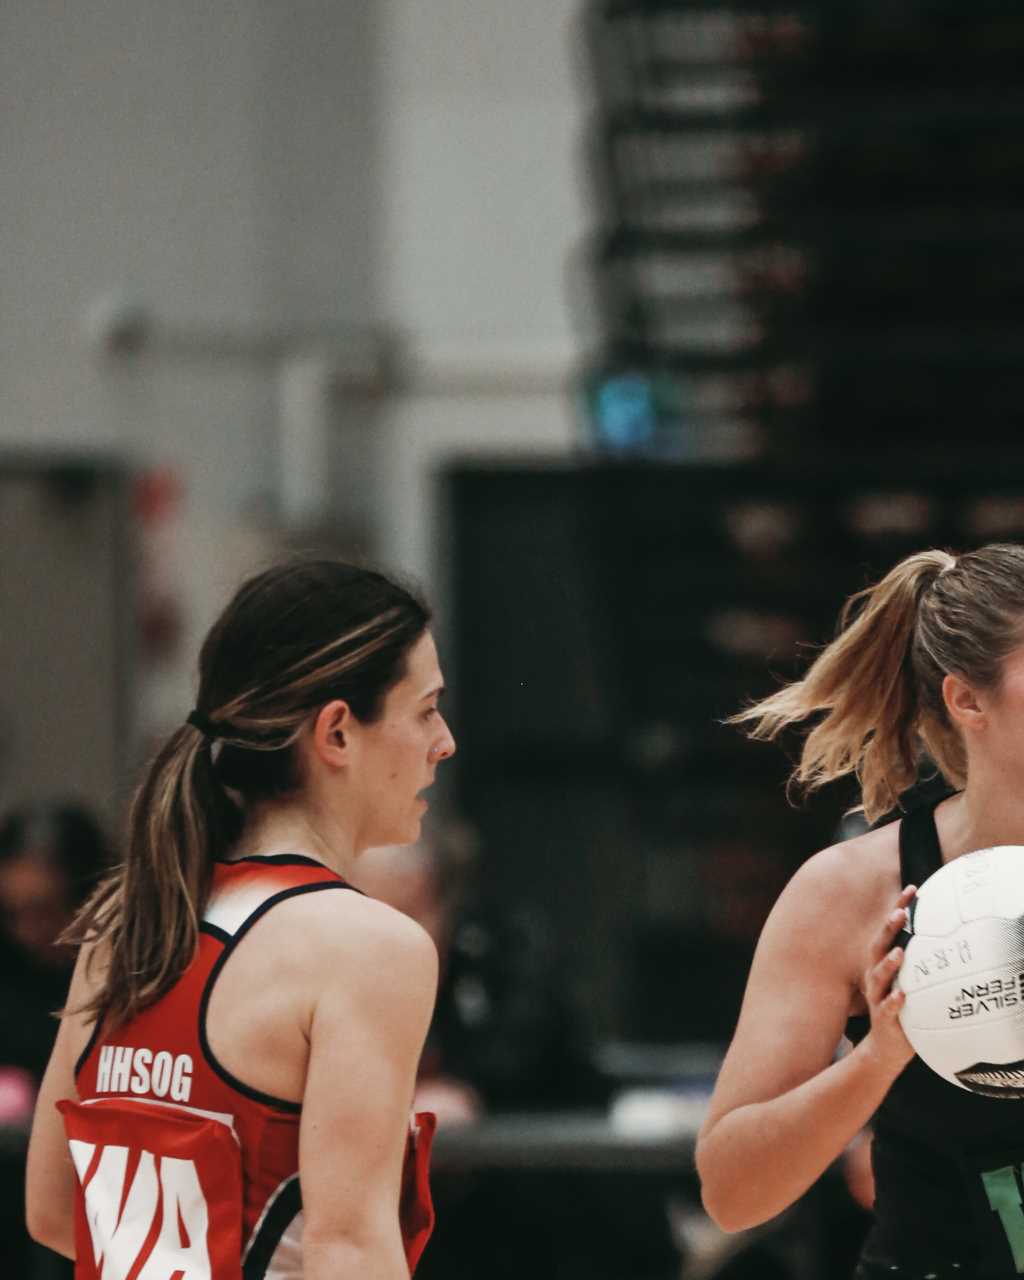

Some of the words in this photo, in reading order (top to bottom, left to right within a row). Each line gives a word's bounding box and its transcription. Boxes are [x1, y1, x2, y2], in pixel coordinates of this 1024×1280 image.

[960, 976, 1016, 1001] FERN
[948, 992, 1018, 1020] SILVER
[96, 1045, 193, 1102] HHSOG
